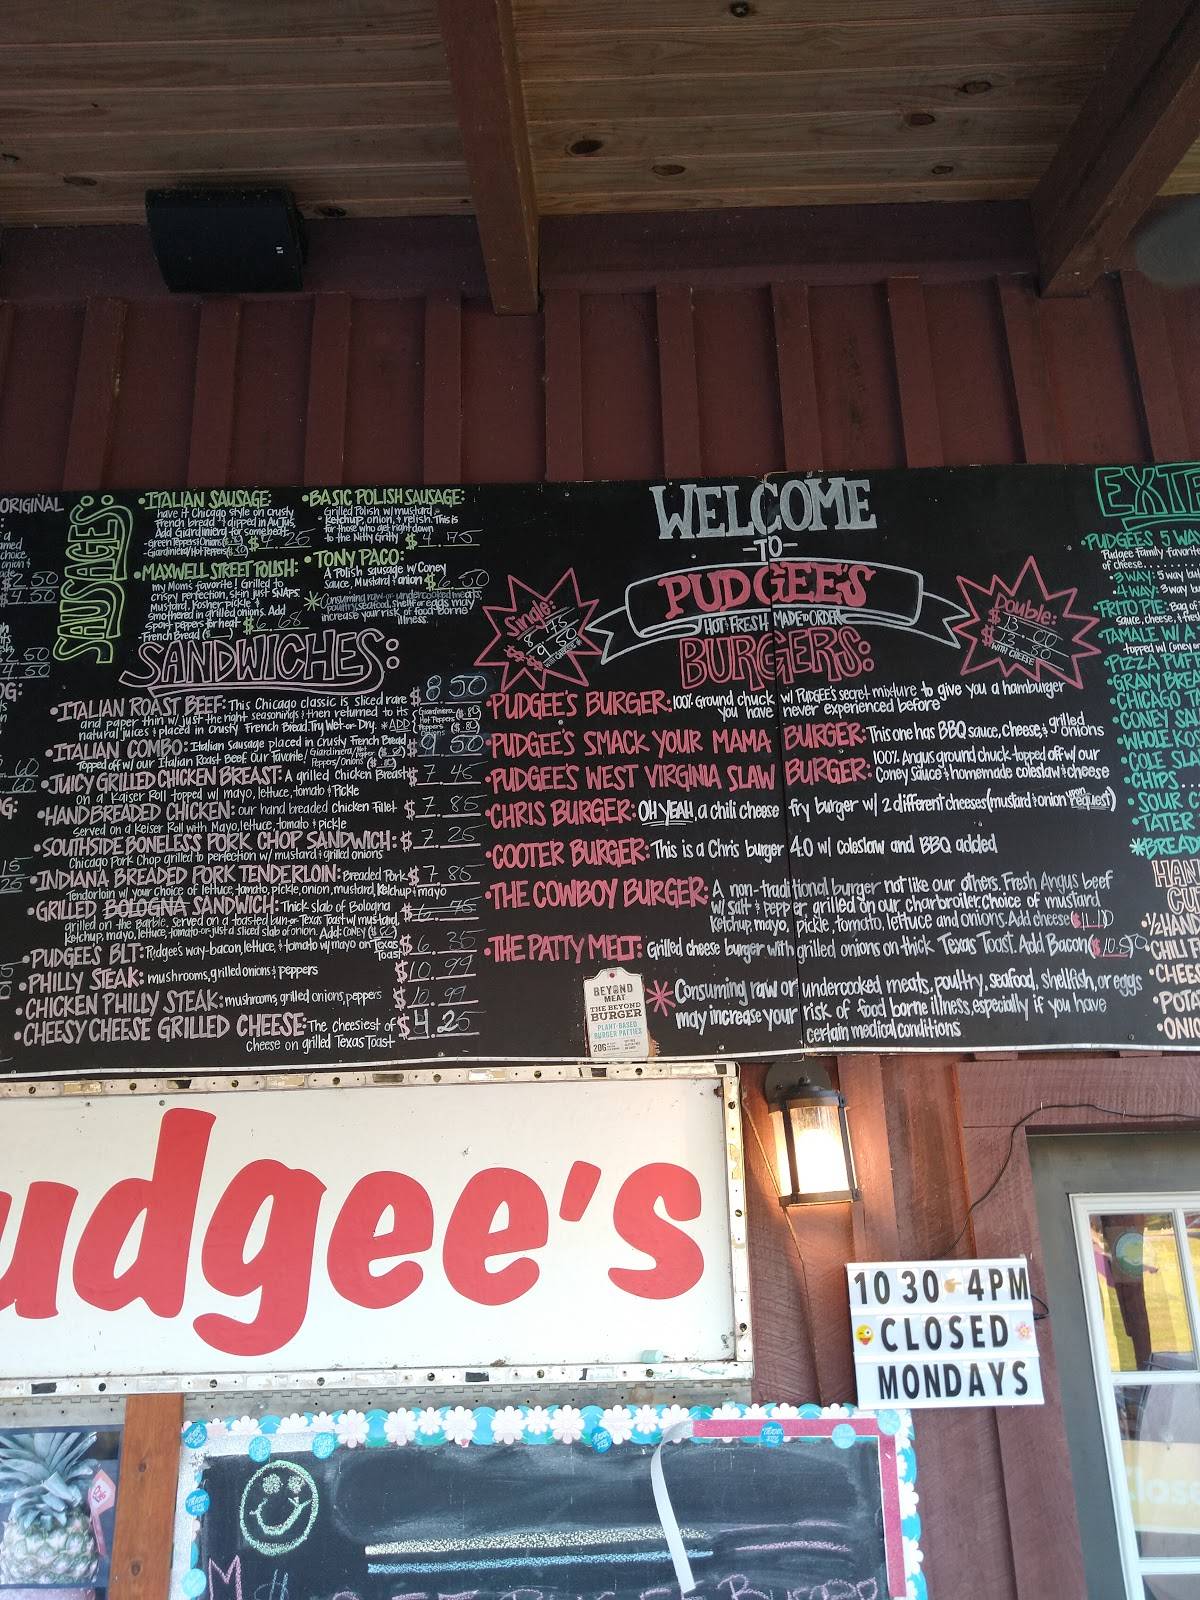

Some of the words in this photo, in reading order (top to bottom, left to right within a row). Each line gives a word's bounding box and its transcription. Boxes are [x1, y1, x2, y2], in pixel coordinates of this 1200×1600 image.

[0, 497, 64, 513] ORIGINAL
[144, 491, 205, 510] ITALIAN
[208, 490, 271, 509] SAUSAGE:
[309, 489, 352, 507] BASIC
[355, 489, 403, 505] POLISH
[649, 477, 877, 539] WELCOME
[157, 510, 178, 518] have
[181, 509, 189, 518] it
[192, 509, 226, 522] Chicago
[229, 508, 250, 517] style
[253, 509, 264, 517] on
[267, 506, 294, 517] crusty
[1160, 530, 1171, 546] 5
[313, 549, 356, 568] TONY
[359, 549, 404, 565] PACO:
[142, 562, 209, 581] MAXWELL
[210, 560, 254, 579] STREET
[1114, 571, 1124, 583] 3
[657, 561, 876, 620] PUDGEE'S
[1117, 585, 1124, 597] 4
[1099, 600, 1138, 618] FRITO
[704, 617, 726, 635] HOT
[730, 613, 769, 633] FRESH
[773, 610, 804, 628] MADE
[808, 609, 842, 626] ORDER
[1102, 627, 1158, 644] TAMALE
[680, 626, 874, 691] BURGERS:
[1107, 654, 1160, 673] PIZZA
[1113, 673, 1161, 692] GRAVY
[57, 699, 124, 722] ITALIAN
[129, 697, 181, 717] ROAST
[185, 695, 226, 716] BEEF:
[490, 690, 578, 720] PUDGEE'S
[585, 690, 672, 717] BURGER:
[1116, 690, 1181, 711] CHICAGO
[1120, 711, 1169, 730] CONEY
[52, 741, 119, 762] ITALIAN
[127, 739, 188, 759] COMBO:
[491, 728, 575, 759] PUDGEE'S
[583, 730, 650, 756] SMACK
[652, 729, 703, 759] YOUR
[712, 729, 772, 753] MAMA
[784, 722, 867, 750] BURGER:
[1123, 730, 1173, 750] WHOLE
[1129, 751, 1166, 771] COLE
[49, 772, 95, 794] JUICY
[96, 772, 156, 792] GRILLED
[158, 767, 216, 788] CHICKEN
[220, 765, 282, 786] BREAST:
[491, 763, 579, 794] PUDGEE'S
[585, 764, 638, 791] WEST
[644, 763, 722, 792] VIRGINIA
[727, 763, 775, 792] SLAW
[784, 757, 873, 786] BURGER:
[1131, 771, 1179, 790] CHIPS
[166, 801, 235, 821] CHICKEN:
[238, 805, 257, 815] our
[261, 802, 285, 815] hand
[288, 800, 328, 814] breaded
[332, 801, 369, 813] Chicken
[372, 801, 397, 813] Fillet
[490, 800, 547, 829] CHRIS
[551, 798, 636, 827] BURGER:
[1138, 792, 1183, 813] SOUR
[1138, 812, 1195, 833] TATER
[42, 837, 121, 857] SOUTHSIDE
[125, 834, 201, 854] BONELESS
[207, 833, 252, 851] PORK
[257, 831, 303, 850] CHOP
[306, 830, 397, 851] SANDWICH:
[492, 841, 564, 870] COOTER
[569, 837, 650, 868] BURGER:
[650, 838, 677, 859] This
[681, 839, 694, 857] is
[696, 843, 704, 857] a
[745, 840, 784, 863] burger
[837, 837, 885, 855] coleslaw
[890, 835, 914, 853] and
[919, 836, 951, 854] BBQ
[955, 833, 998, 854] added
[36, 868, 109, 891] INDIANA
[114, 867, 188, 888] BREADED
[192, 864, 236, 885] PORK
[239, 864, 341, 883] TENDERLOIN:
[489, 880, 530, 909] THE
[533, 879, 618, 909] COWBOY
[623, 876, 708, 908] BURGER:
[36, 899, 97, 922] GRILLED
[104, 899, 189, 920] BOLOGNA
[192, 895, 279, 917] SANDWICH:
[30, 943, 102, 969] PUDGEE'S
[109, 943, 145, 965] BLT:
[488, 934, 525, 962] THE
[527, 934, 584, 964] PATTY
[1151, 939, 1188, 961] CHILI
[28, 972, 83, 994] PHILLY
[89, 966, 145, 992] STEAK:
[594, 984, 633, 996] BEYOND
[674, 977, 748, 1006] Consuming
[750, 979, 777, 1000] raw
[802, 975, 881, 998] undercooked
[1098, 976, 1111, 990] or
[1113, 974, 1142, 997] eggs
[25, 993, 98, 1020] CHICKEN
[102, 991, 160, 1016] PHILLY
[163, 989, 223, 1013] STEAK:
[604, 994, 625, 1002] MEAT
[608, 1002, 641, 1010] BEYOND
[591, 1009, 642, 1021] BURGER
[675, 1008, 707, 1035] may
[709, 1004, 762, 1026] increase
[763, 1007, 798, 1031] your
[803, 1002, 832, 1021] risk
[836, 998, 851, 1019] of
[857, 997, 887, 1018] food
[890, 997, 928, 1017] borne
[23, 1020, 87, 1047] CHEESY
[89, 1017, 152, 1042] CHEESE
[158, 1015, 230, 1042] GRILLED
[237, 1012, 307, 1037] CHEESE:
[967, 1267, 1029, 1301] 4PM
[880, 1314, 1009, 1352] CLOSED
[877, 1360, 1028, 1400] MONDAYS
